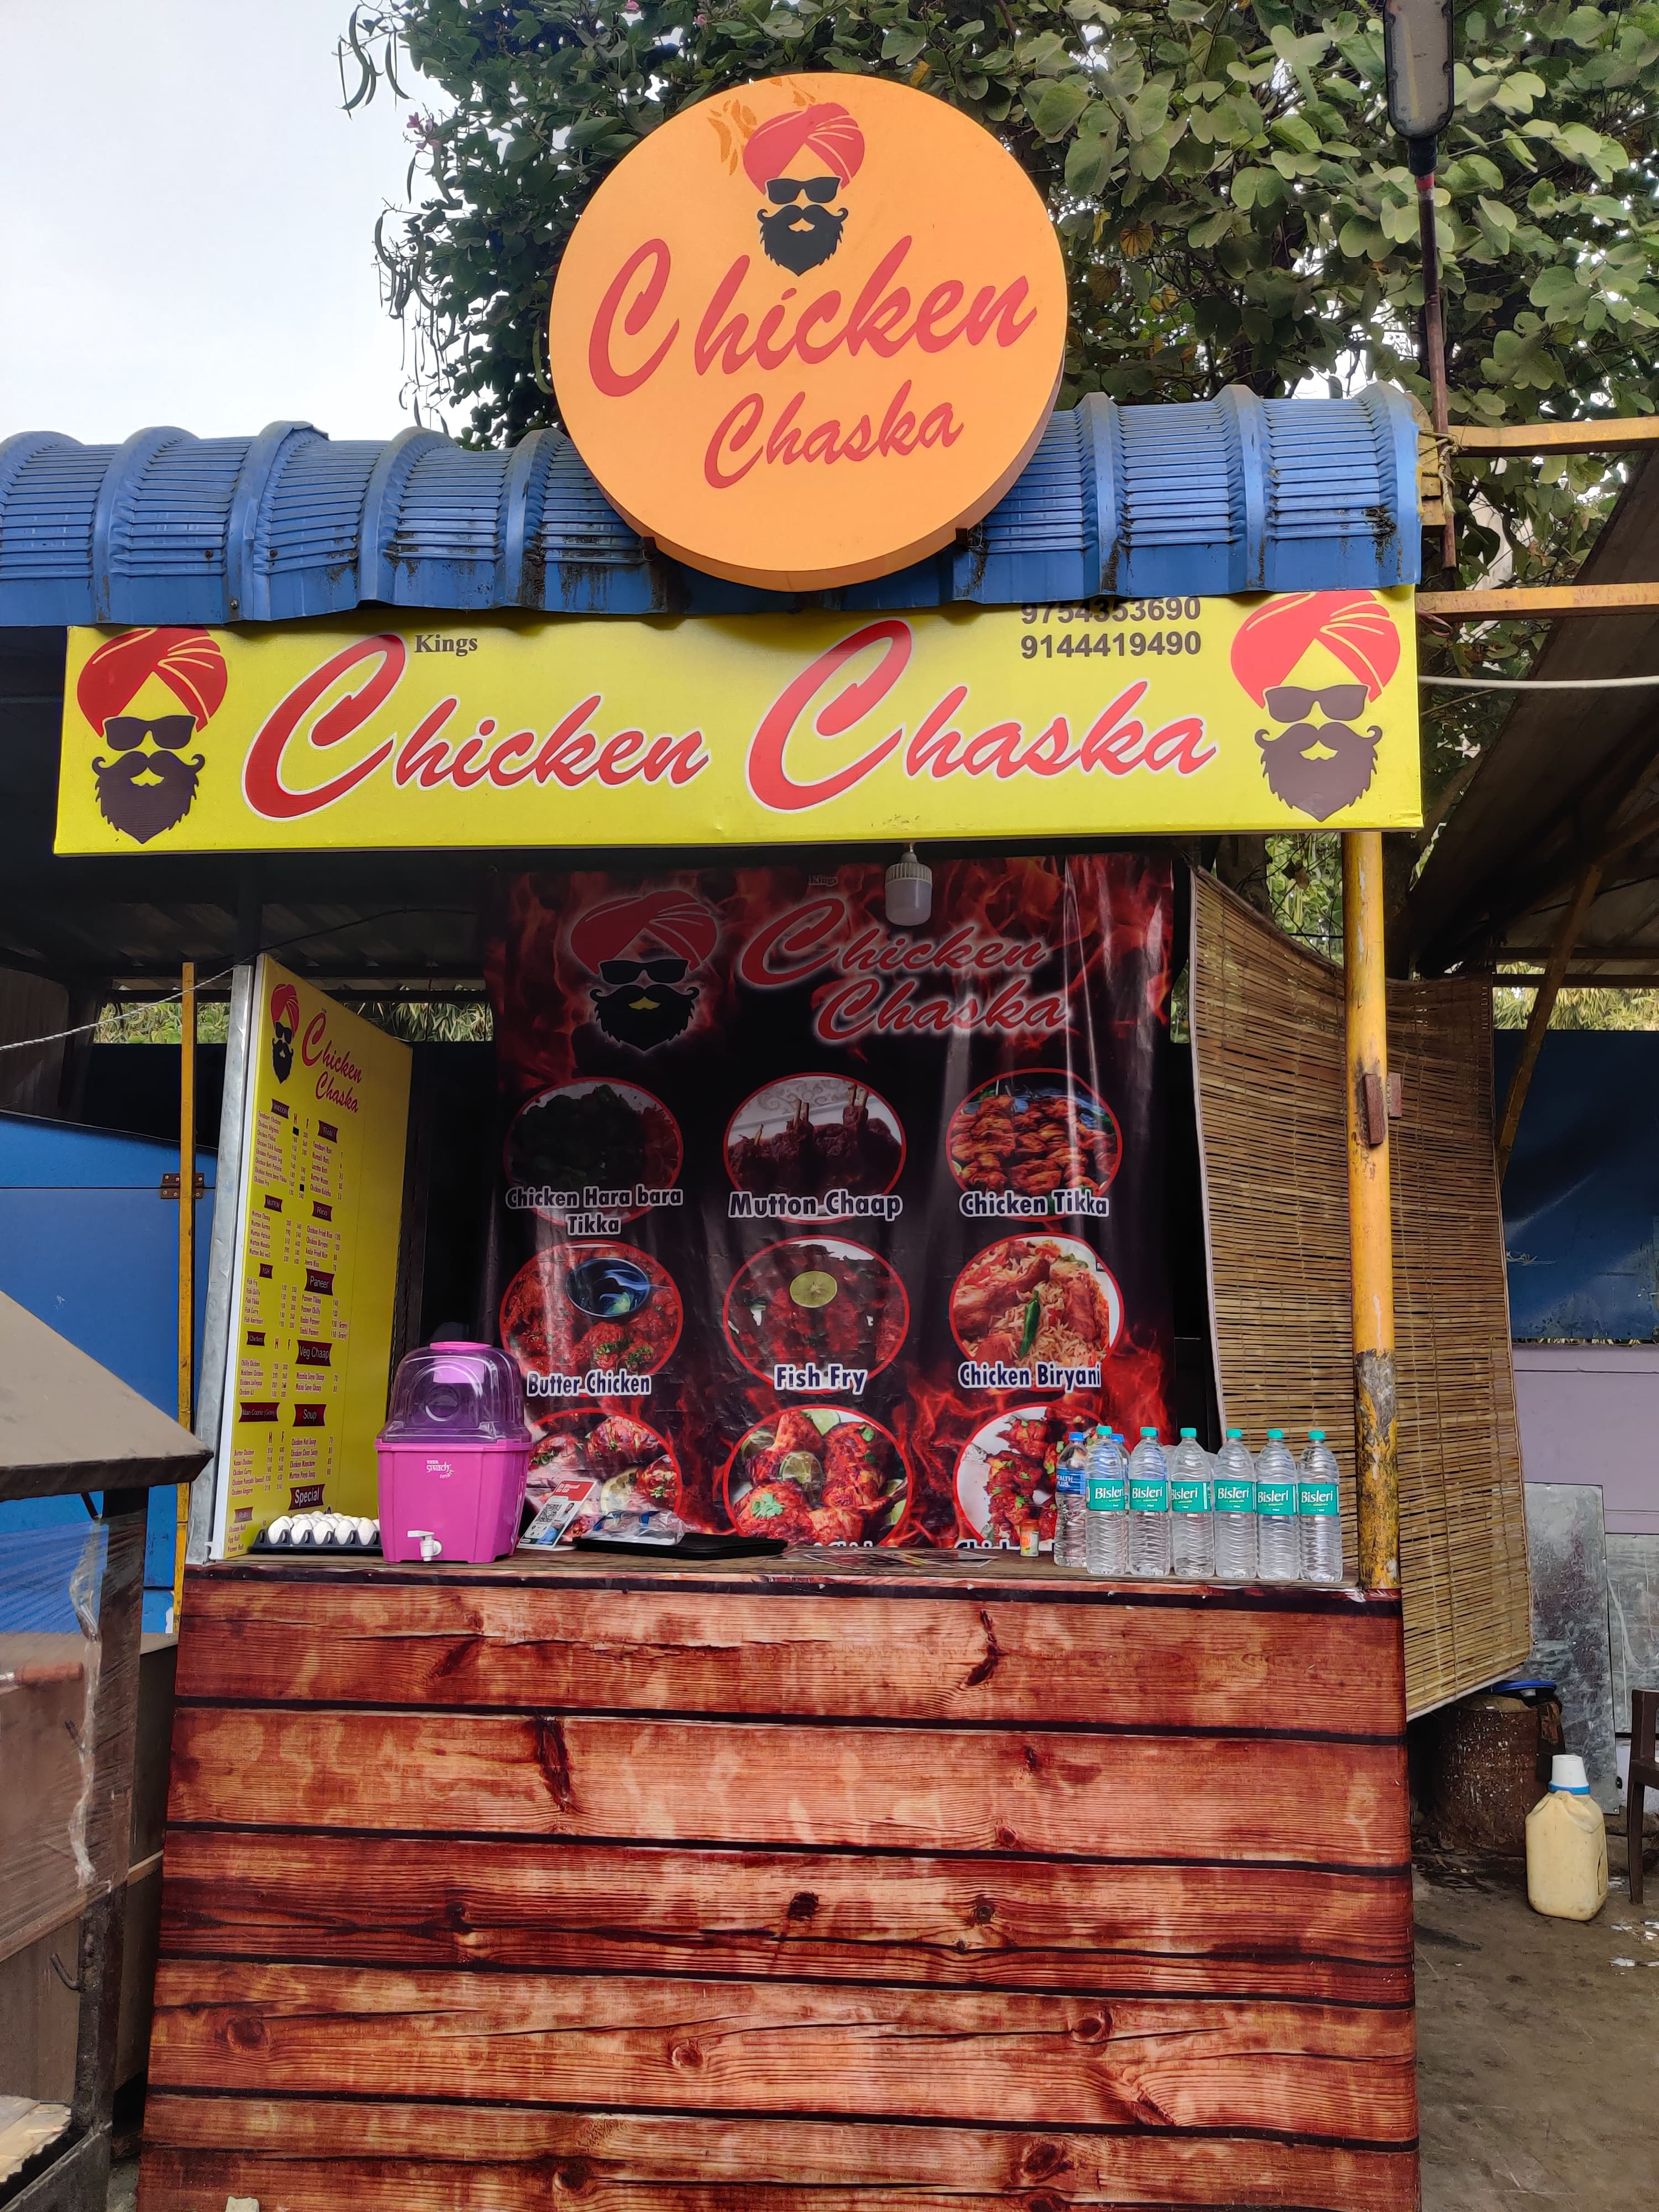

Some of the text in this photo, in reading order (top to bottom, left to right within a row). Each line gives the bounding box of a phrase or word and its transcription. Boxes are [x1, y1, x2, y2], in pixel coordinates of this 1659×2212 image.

[588, 235, 1037, 397] Chicken
[704, 379, 964, 489] Chaska
[1021, 597, 1201, 624] 9754353690
[414, 633, 478, 656] Kings
[1021, 631, 1201, 659] 9144419490
[244, 619, 1217, 819] Chicken Chaska
[741, 897, 1048, 985] Chicken
[817, 978, 1069, 1040] Chaska
[302, 1012, 362, 1084] Chicken
[315, 1071, 358, 1113] Chaska
[507, 1185, 682, 1207] Chicken Hara bara
[729, 1190, 901, 1220] Mutton Chaap
[961, 1191, 1107, 1215] Chicken Tikka
[568, 1215, 619, 1234] Tikka
[310, 1275, 329, 1289] Paneer
[299, 1345, 329, 1362] Veg Chaap
[528, 1370, 650, 1395] Butter Chicken
[776, 1365, 866, 1394] Fish Fry
[959, 1363, 1100, 1392] Chicken Biryani
[302, 1408, 317, 1422] Soup
[294, 1486, 320, 1507] Special
[1095, 1486, 1124, 1499] Bisleri
[1132, 1486, 1163, 1499] Bisleri
[1217, 1488, 1249, 1499] Bisleri
[1258, 1490, 1288, 1503] Bisleri
[1301, 1490, 1333, 1503] Bisleri
